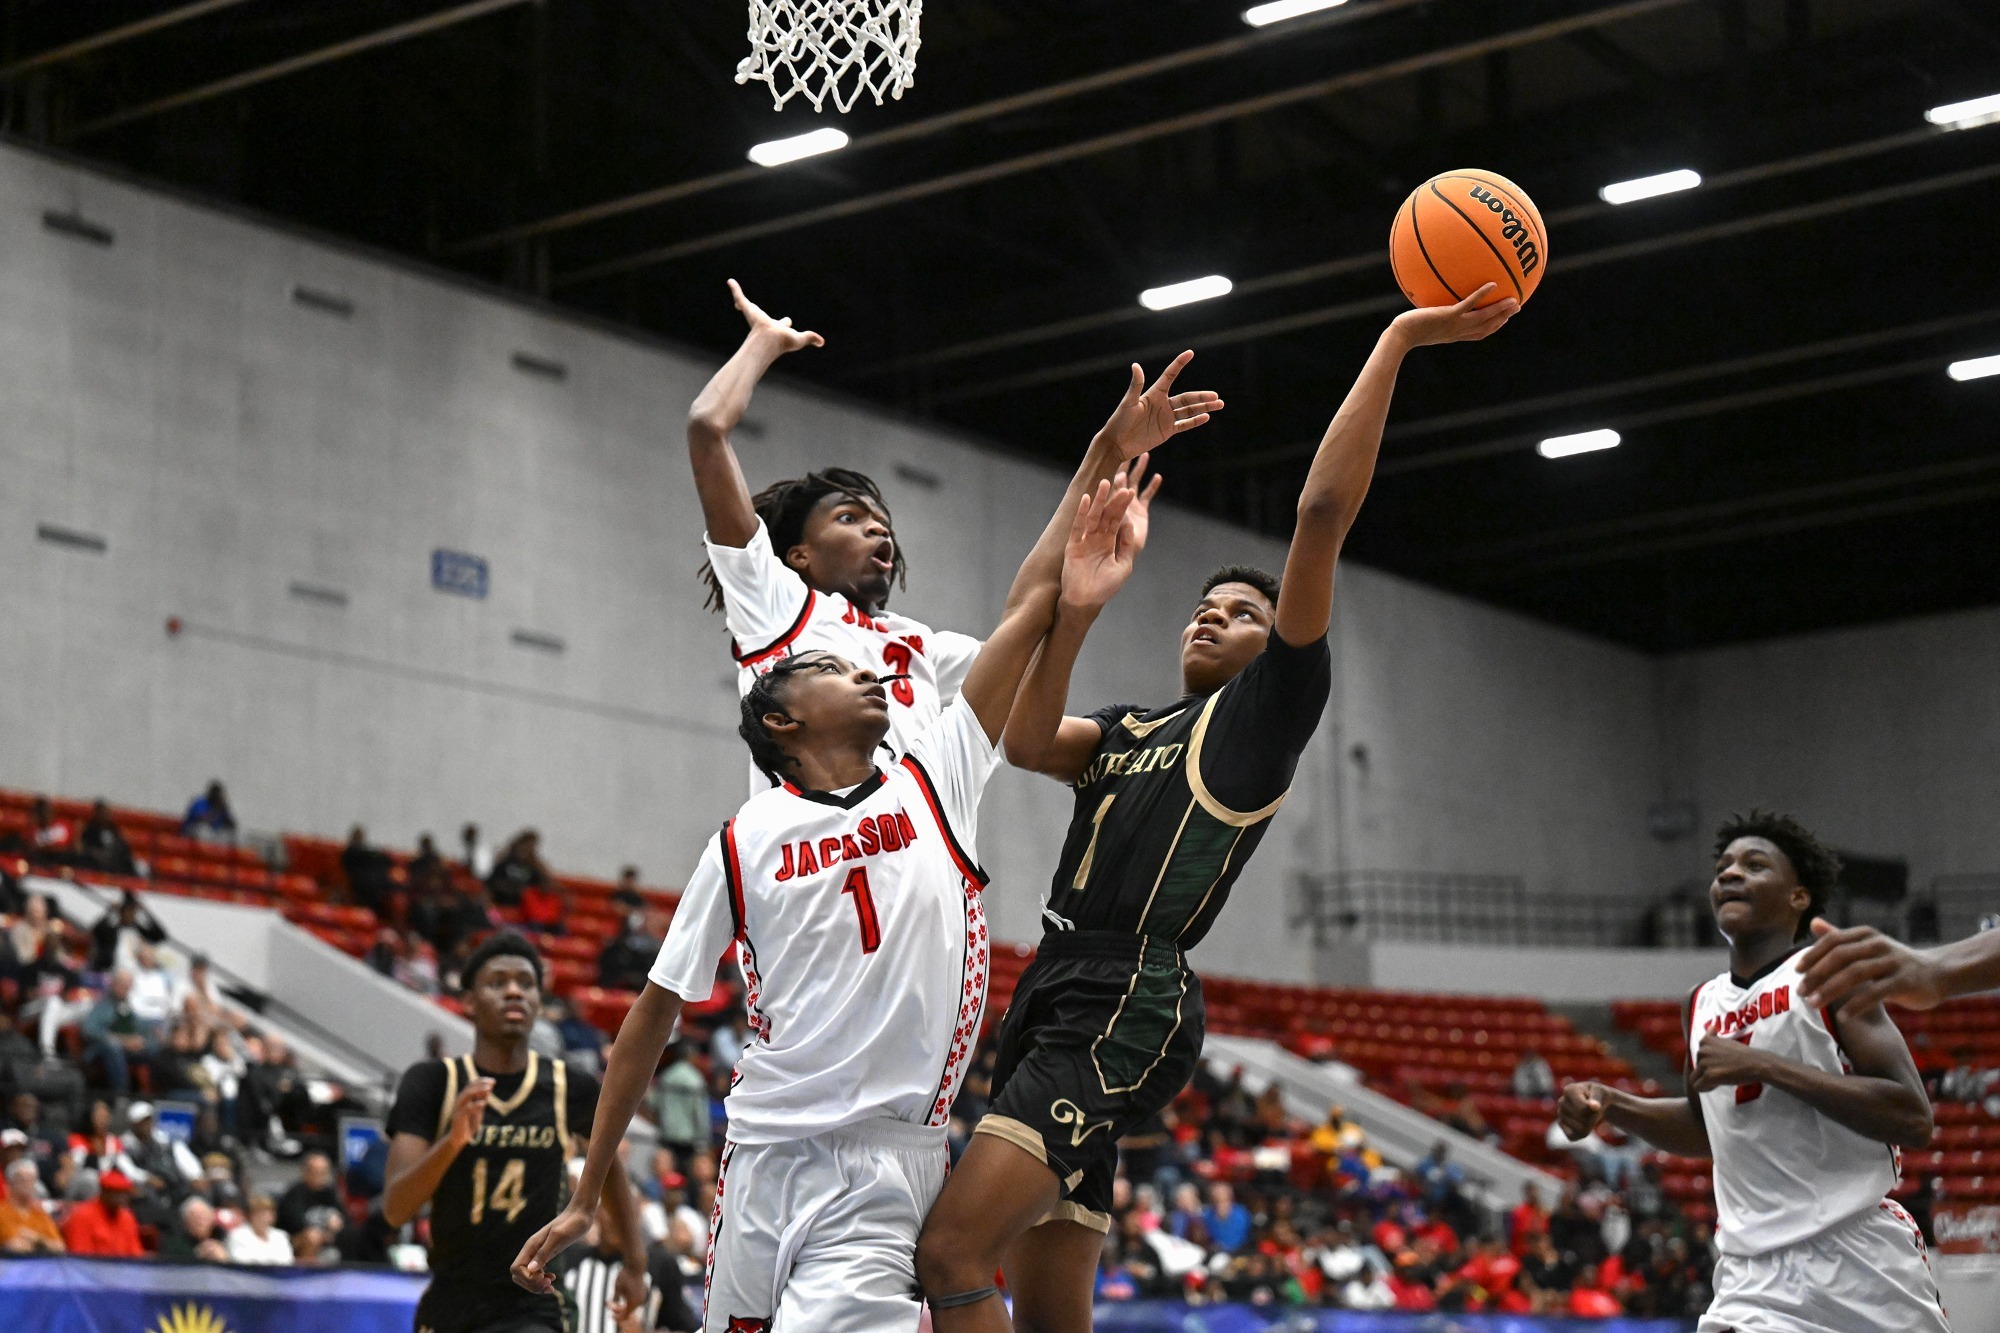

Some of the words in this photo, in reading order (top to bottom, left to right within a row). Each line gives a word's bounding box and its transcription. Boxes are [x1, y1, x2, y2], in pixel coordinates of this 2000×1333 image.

[1469, 184, 1539, 279] Wilson
[775, 806, 917, 882] JACKSON
[1072, 794, 1117, 890] 1
[841, 865, 881, 955] 1
[468, 1124, 555, 1149] UFFALO
[470, 1158, 528, 1224] 14
